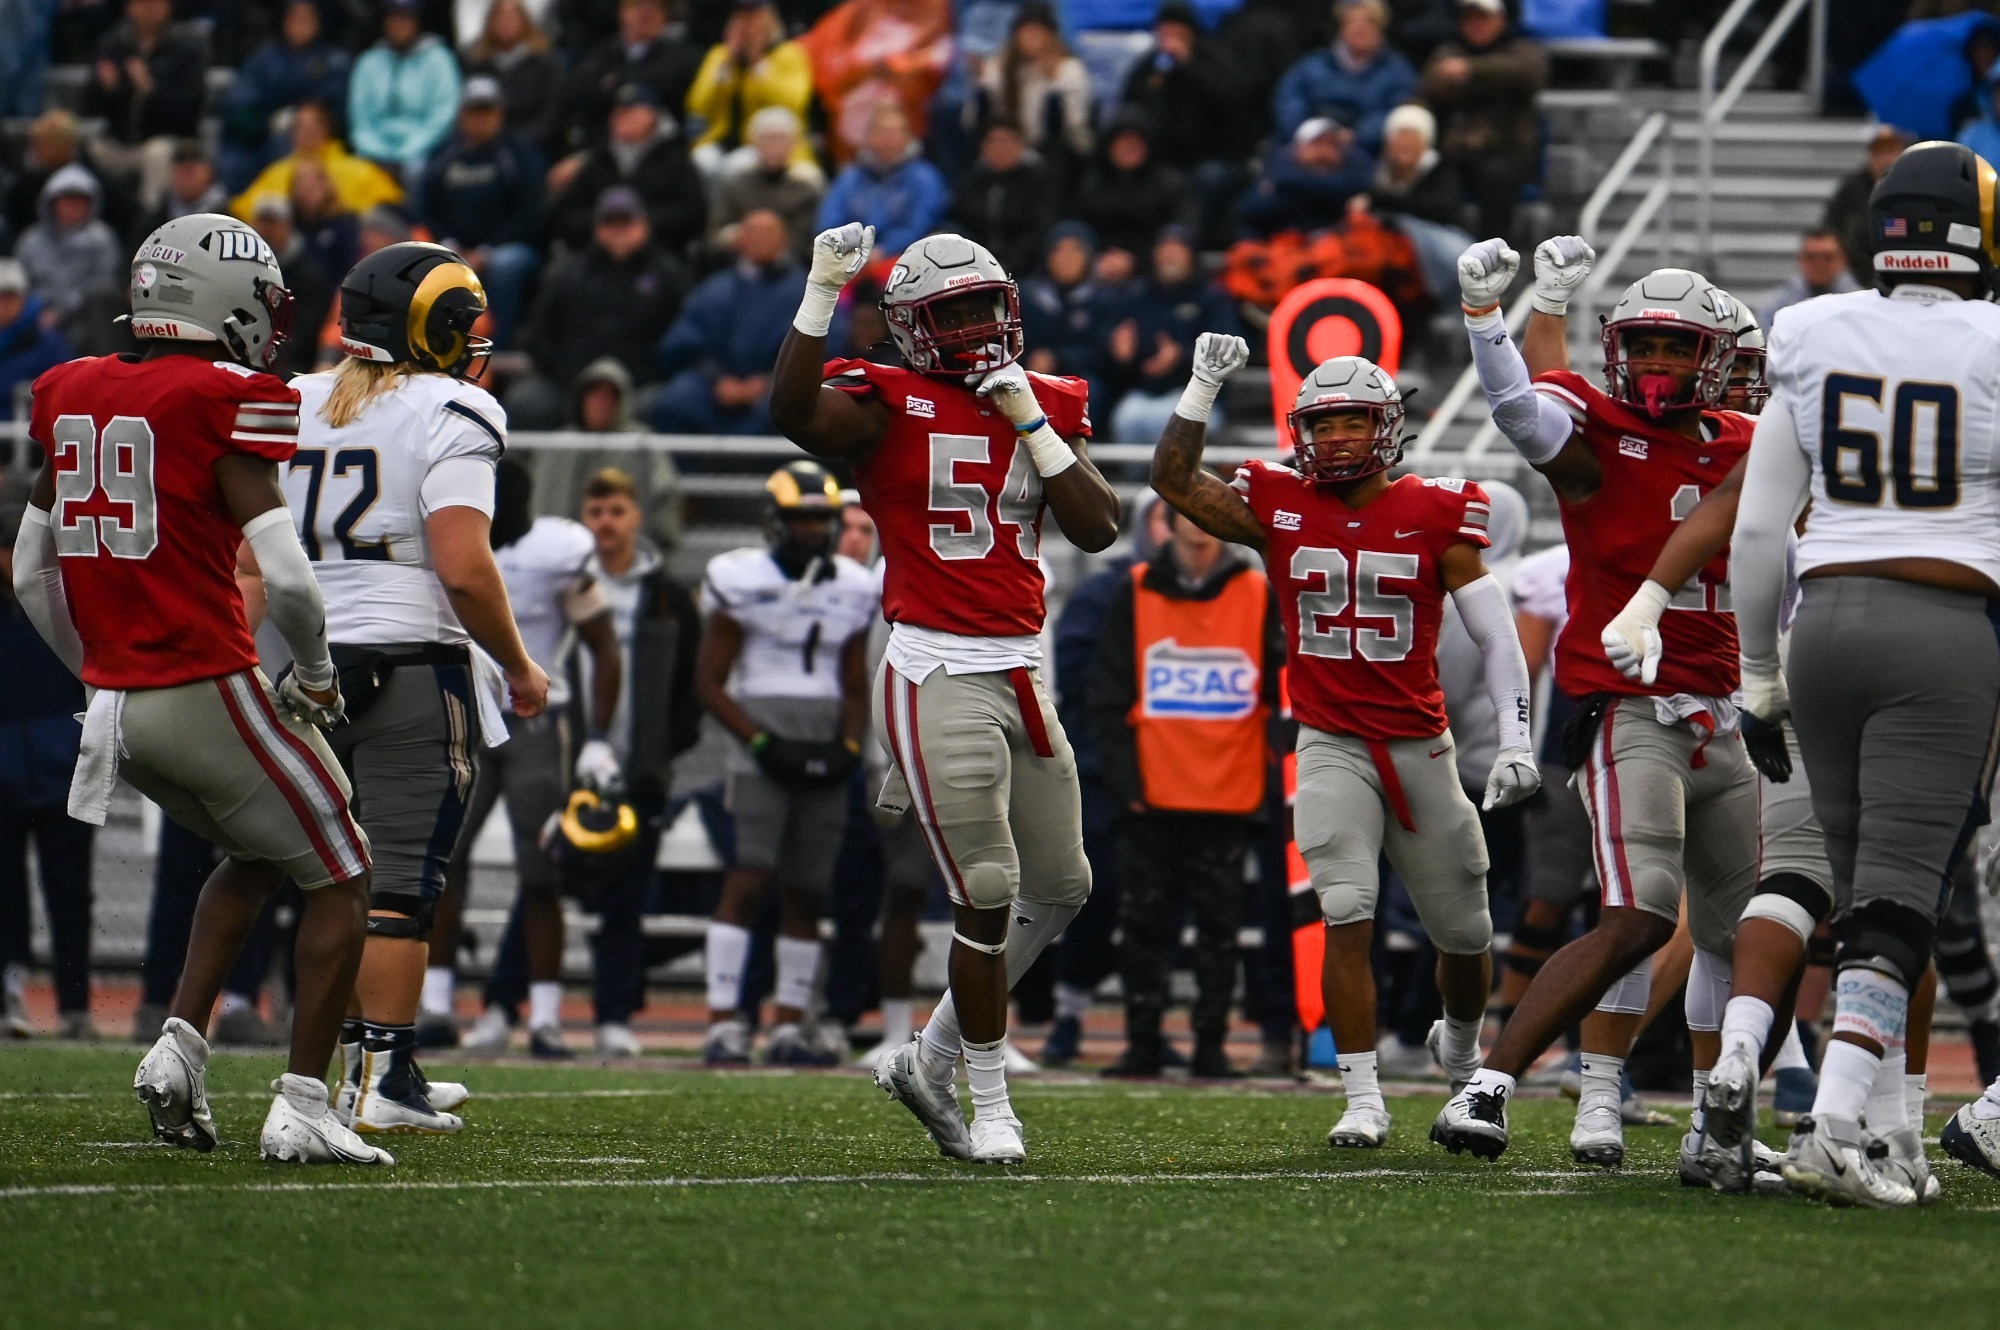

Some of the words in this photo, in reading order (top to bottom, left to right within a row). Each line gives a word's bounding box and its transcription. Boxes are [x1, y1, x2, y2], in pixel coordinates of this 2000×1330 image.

[151, 246, 185, 264] GUY
[217, 231, 274, 269] IUP
[1883, 255, 1950, 270] Riddell
[948, 274, 981, 287] Riddell
[342, 342, 374, 359] ddell
[906, 400, 936, 414] PSAC
[1618, 437, 1649, 456] PSAC
[1821, 372, 1961, 509] 60
[51, 414, 158, 560] 29
[928, 433, 1046, 561] 54
[287, 446, 395, 561] 72
[1273, 514, 1302, 527] PSAC
[1290, 545, 1420, 663] 25
[1149, 664, 1251, 697] PSAC
